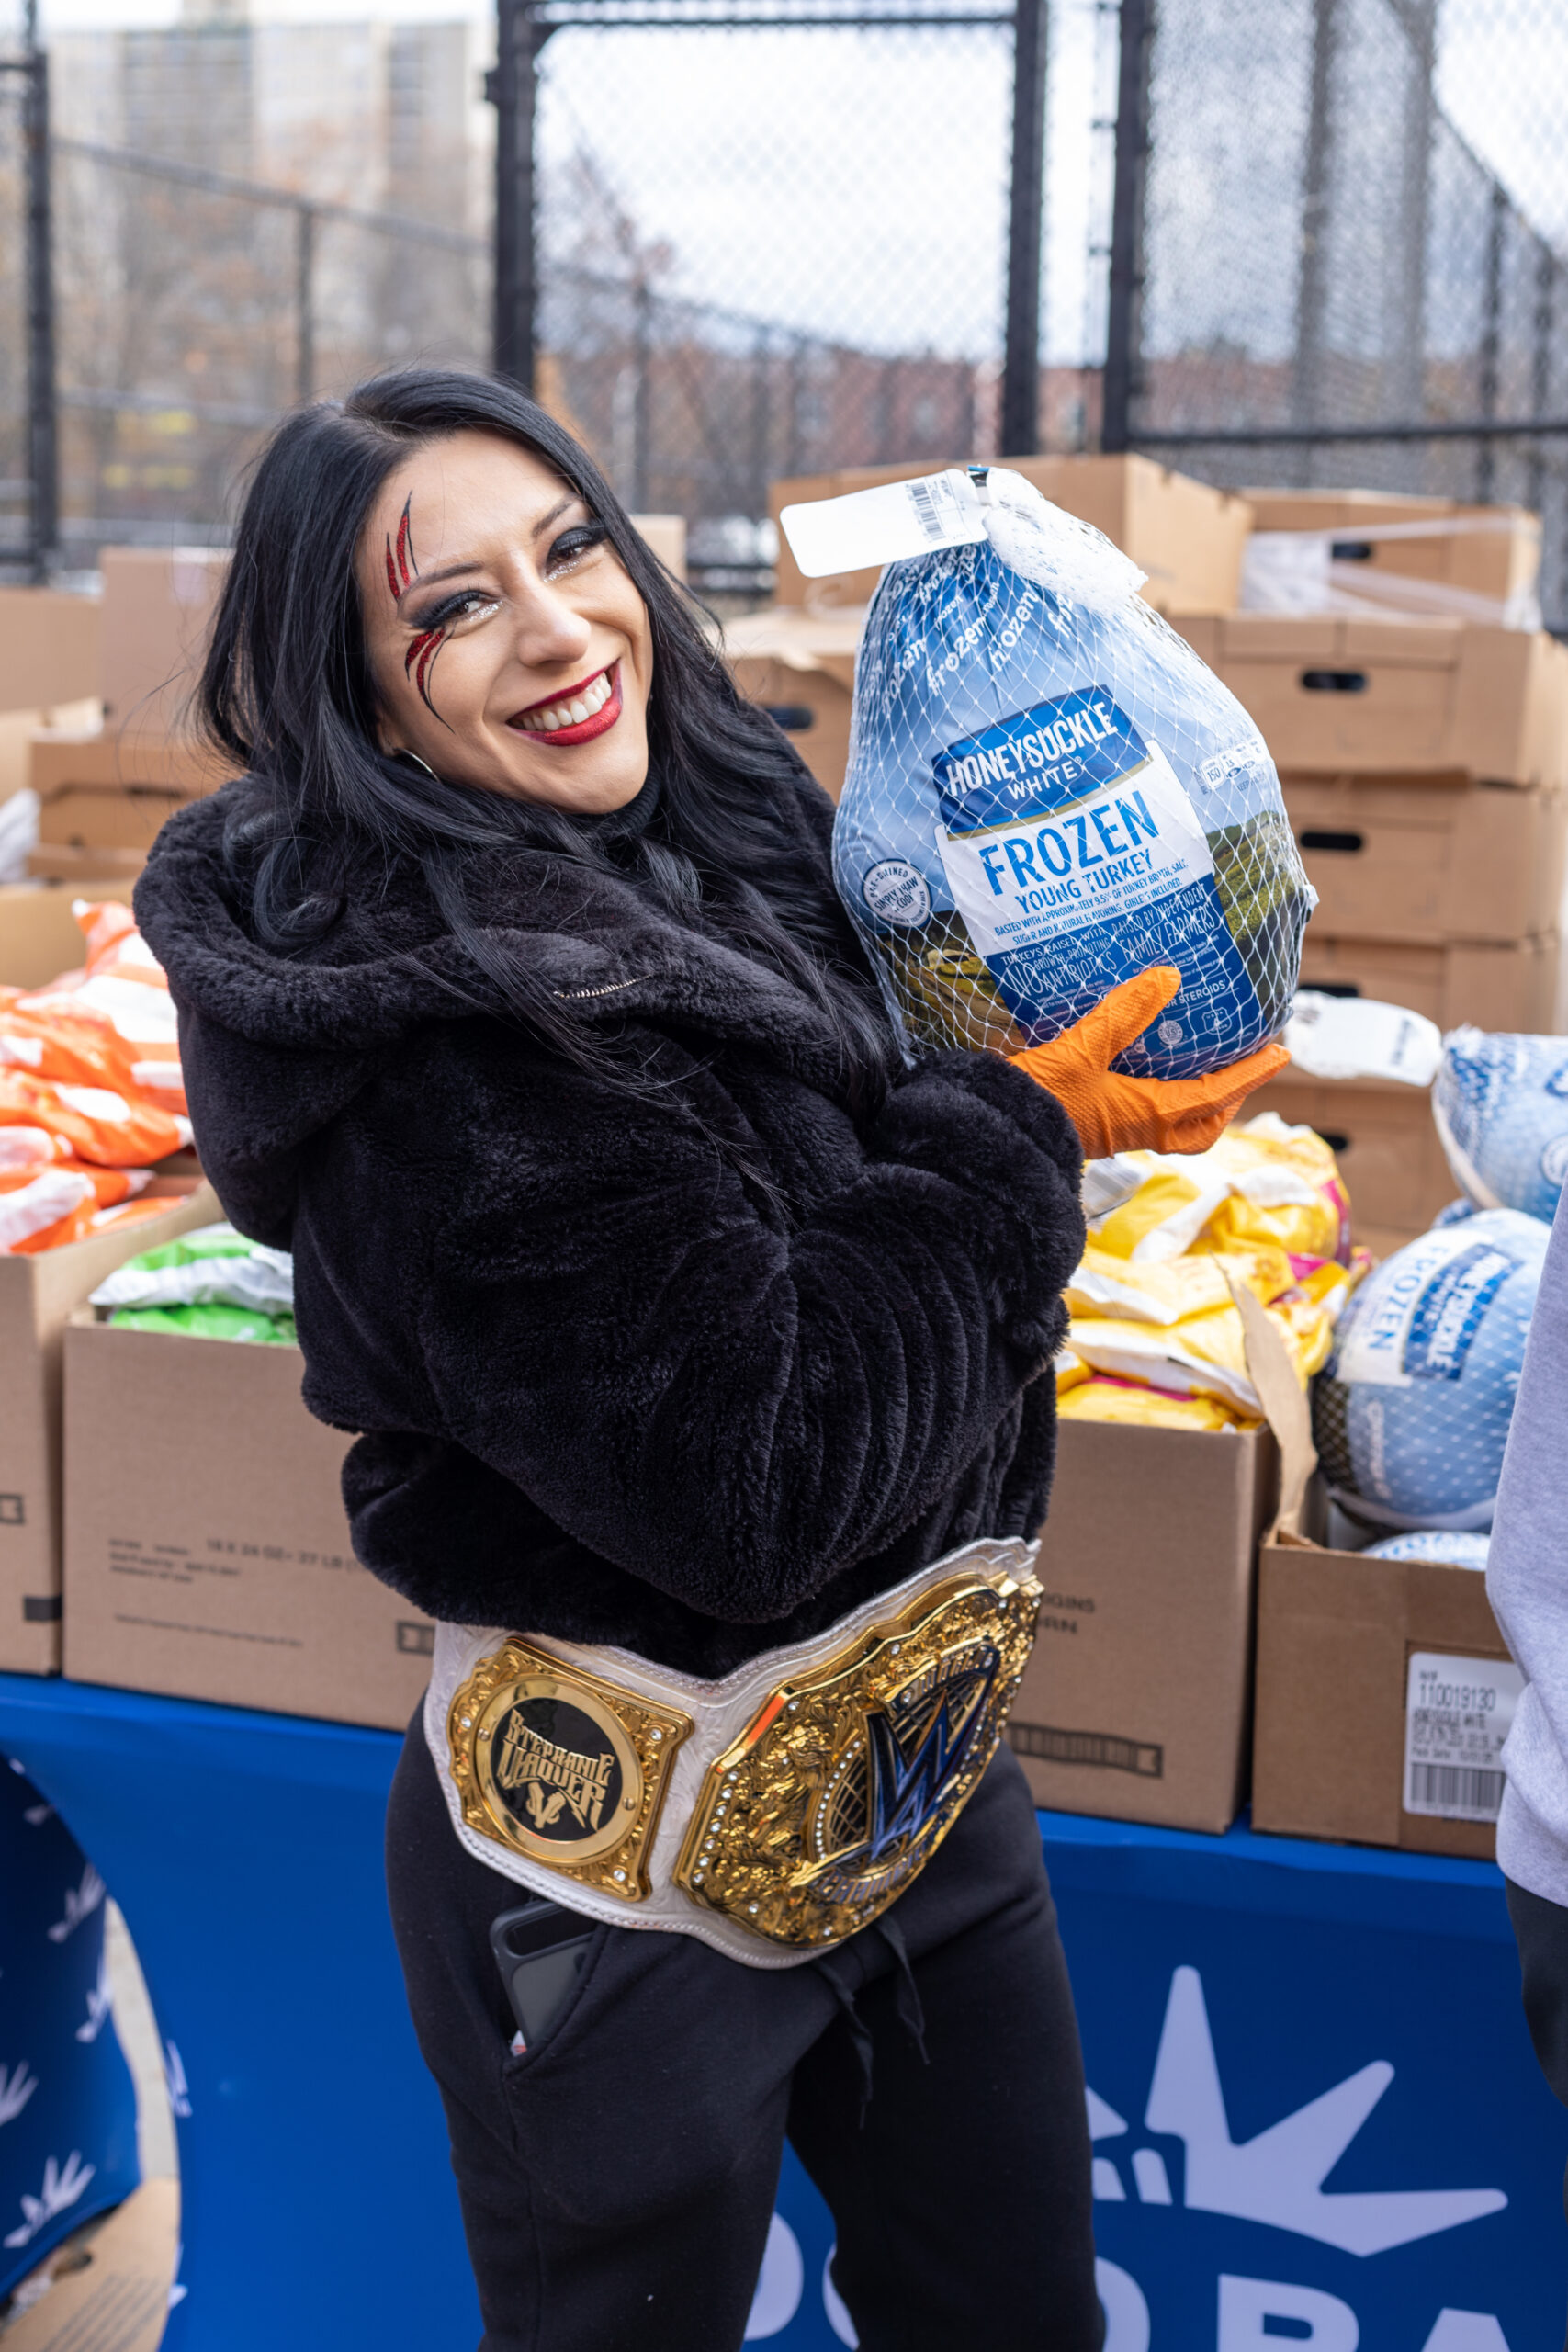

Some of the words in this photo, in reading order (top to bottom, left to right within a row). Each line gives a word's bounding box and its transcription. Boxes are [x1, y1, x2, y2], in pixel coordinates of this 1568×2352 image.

[926, 616, 986, 696] frozen
[946, 702, 1118, 796] HONEYSUCKLE
[979, 790, 1159, 896] FROZEN
[874, 889, 897, 911] SIMPLY
[994, 922, 1021, 936] BASTED
[1021, 915, 1042, 929] WITH
[1111, 888, 1122, 899] OF
[1122, 876, 1147, 895] TURKEY
[1015, 879, 1082, 914] YOUNG
[1082, 848, 1152, 893] TURKEY
[1111, 914, 1144, 937] RAISED
[1144, 909, 1155, 926] BY
[1156, 883, 1206, 919] INDEPENDENT
[1001, 948, 1043, 965] TURKEYS
[1044, 937, 1077, 954] RAISED
[1081, 927, 1106, 941] WITH
[1038, 927, 1054, 937] AND
[1120, 925, 1164, 964] FAMILY
[1164, 902, 1214, 947] FARMERS
[1006, 962, 1043, 996] NO
[1042, 951, 1117, 991] ANTIBIOTICS
[504, 1708, 615, 1786] STEPHANIE
[497, 1739, 607, 1831] VAQUER
